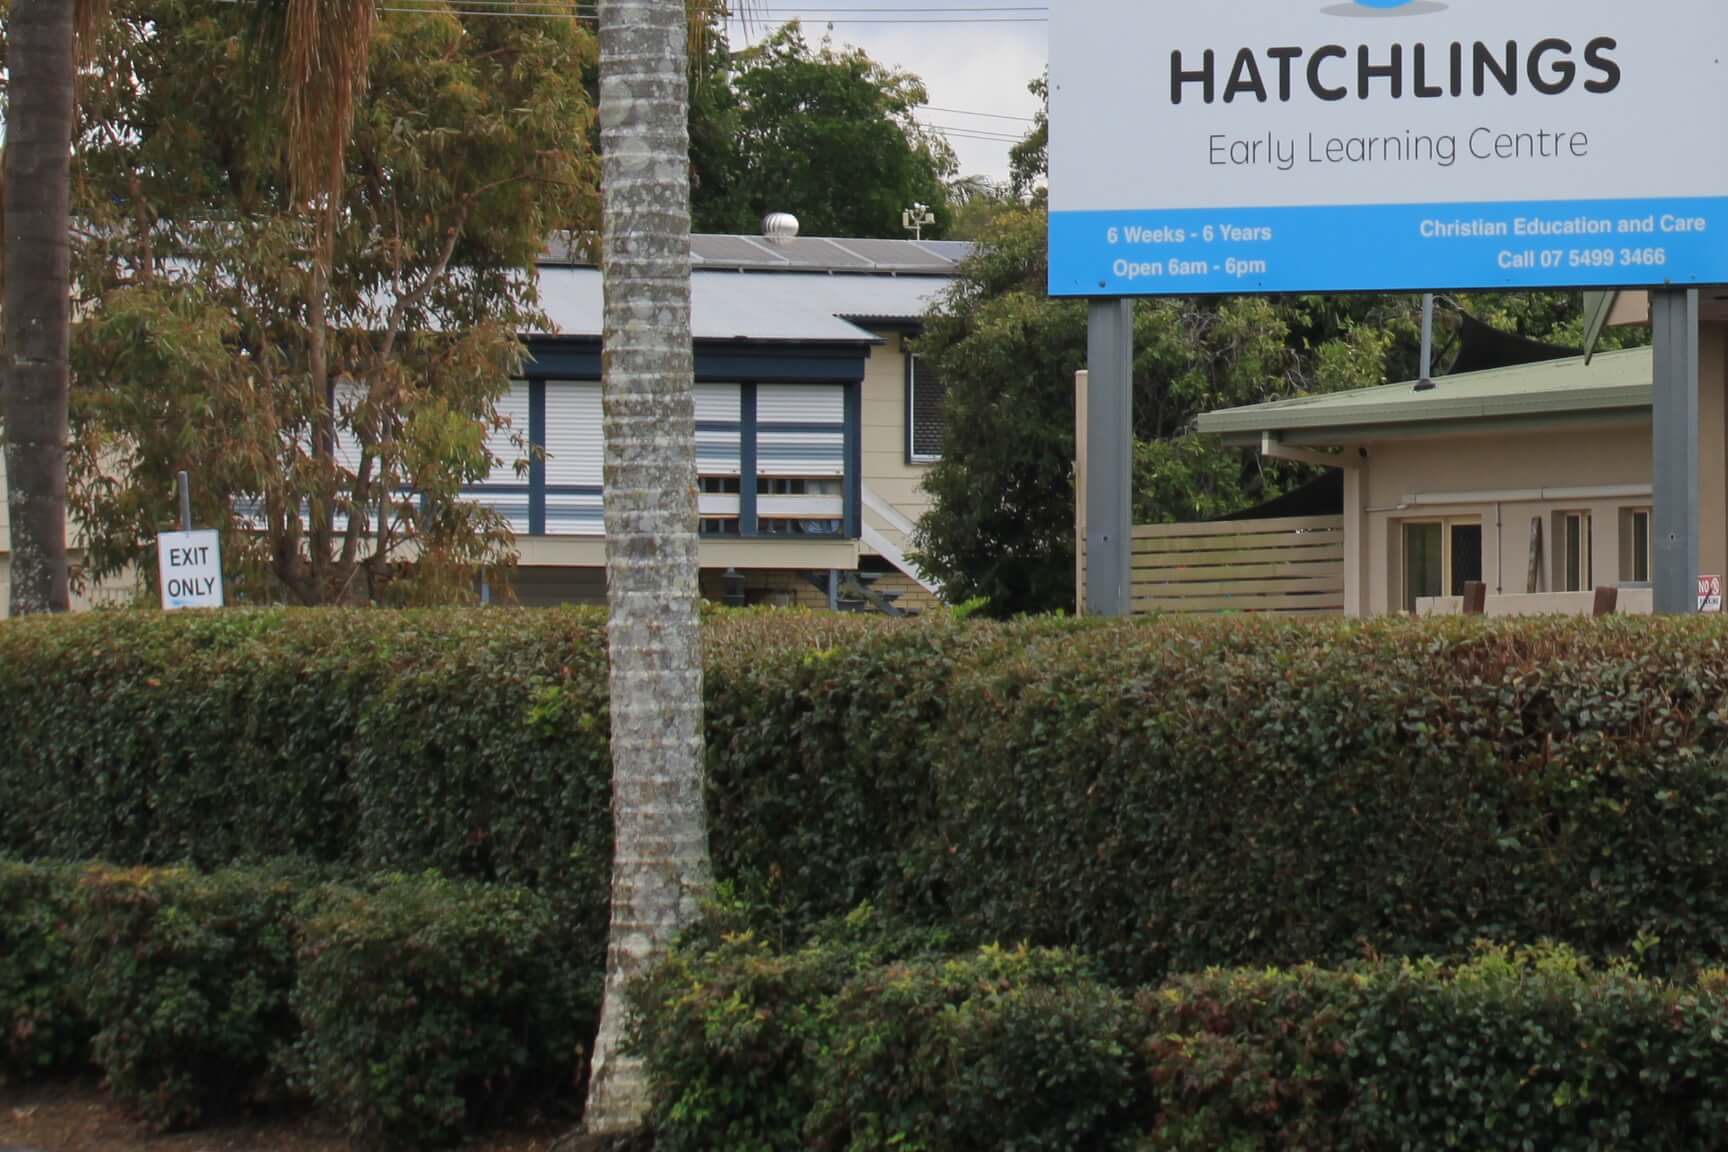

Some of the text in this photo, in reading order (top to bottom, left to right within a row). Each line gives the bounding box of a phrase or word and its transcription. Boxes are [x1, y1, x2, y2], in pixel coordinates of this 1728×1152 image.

[1171, 36, 1620, 105] HATCHLINGS
[1209, 128, 1588, 171] Early Learning Centre
[1107, 227, 1118, 244] 6
[1124, 226, 1185, 243] Weeks
[1202, 225, 1214, 242] 6
[1220, 224, 1272, 241] Years
[1420, 214, 1706, 237] Christian Education and Care
[1113, 258, 1163, 280] Open
[1168, 258, 1207, 275] 6am
[1225, 257, 1266, 277] 6pm
[1497, 248, 1666, 269] Call 07 5499 3466
[170, 546, 208, 566] EXIT
[168, 577, 215, 597] ONLY
[1698, 580, 1709, 592] NO
